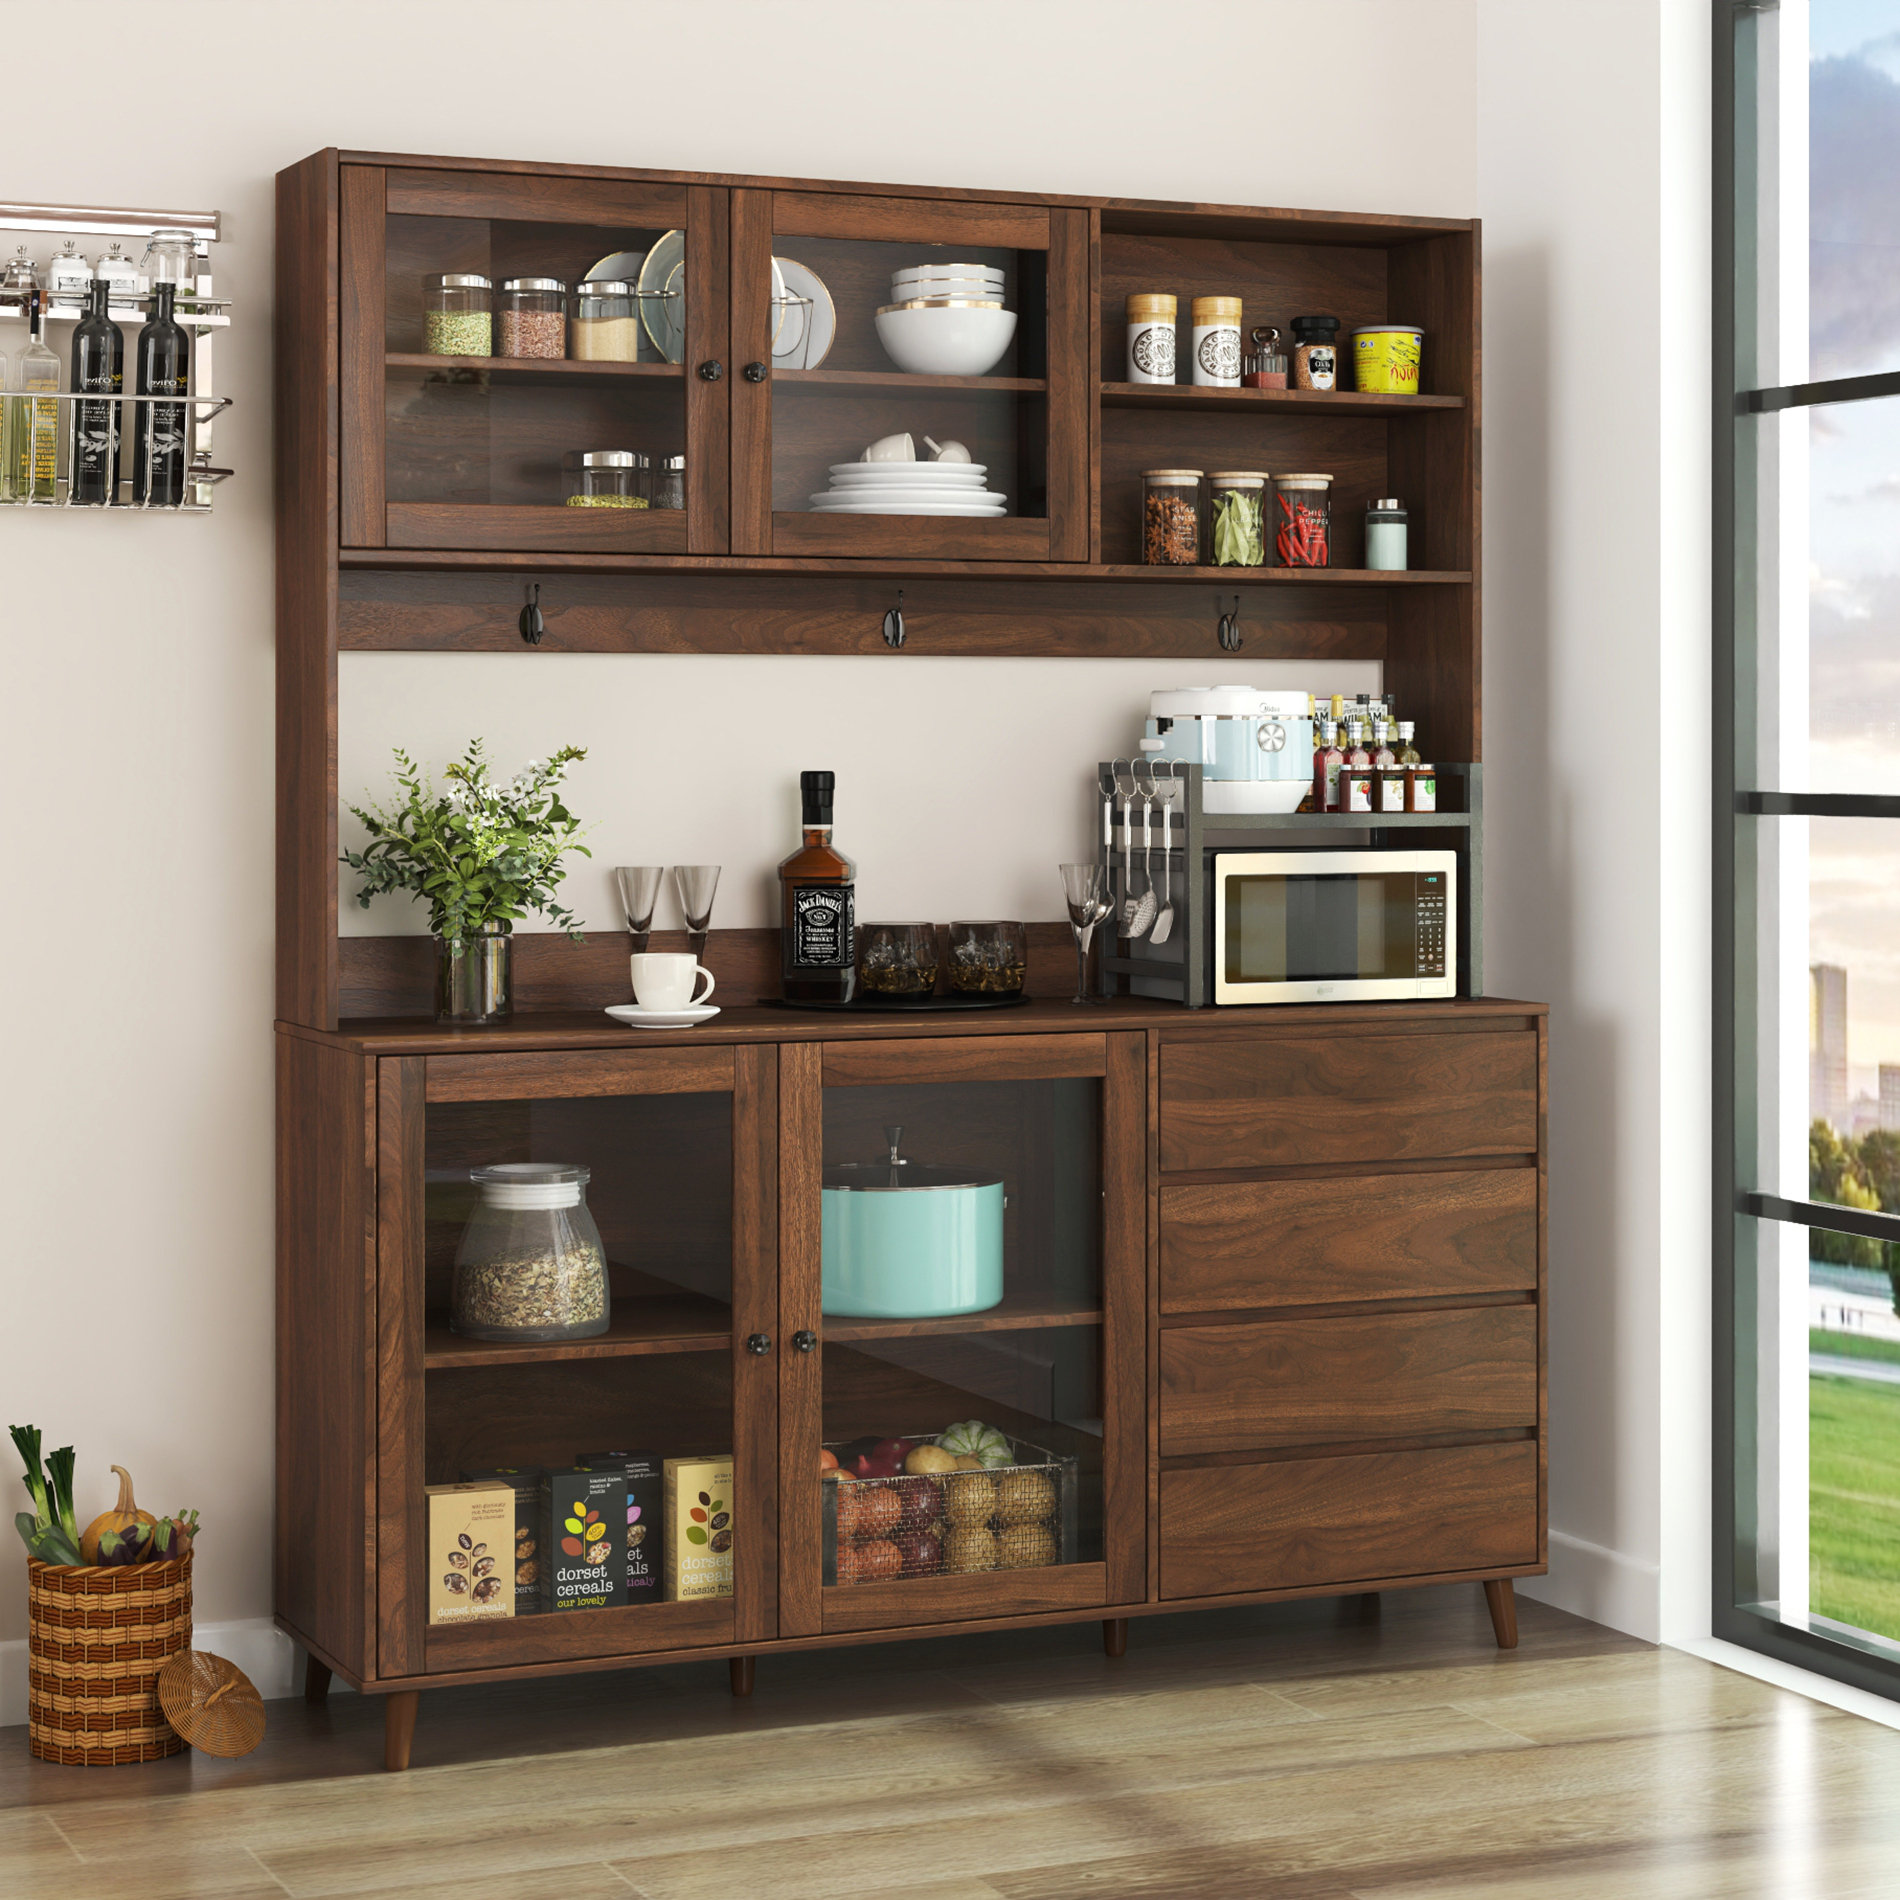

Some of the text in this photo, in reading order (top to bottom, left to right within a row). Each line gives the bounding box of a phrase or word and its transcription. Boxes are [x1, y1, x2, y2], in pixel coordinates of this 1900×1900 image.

[1174, 506, 1195, 514] STAR
[1172, 514, 1197, 522] ANISE
[798, 897, 815, 913] JACK
[681, 1555, 731, 1570] dorset
[556, 1564, 608, 1581] dorset
[556, 1579, 614, 1597] cereals
[682, 1583, 732, 1596] classic fru
[437, 1605, 469, 1617] dorset
[471, 1601, 507, 1613] cereals
[557, 1595, 607, 1608] our lovely
